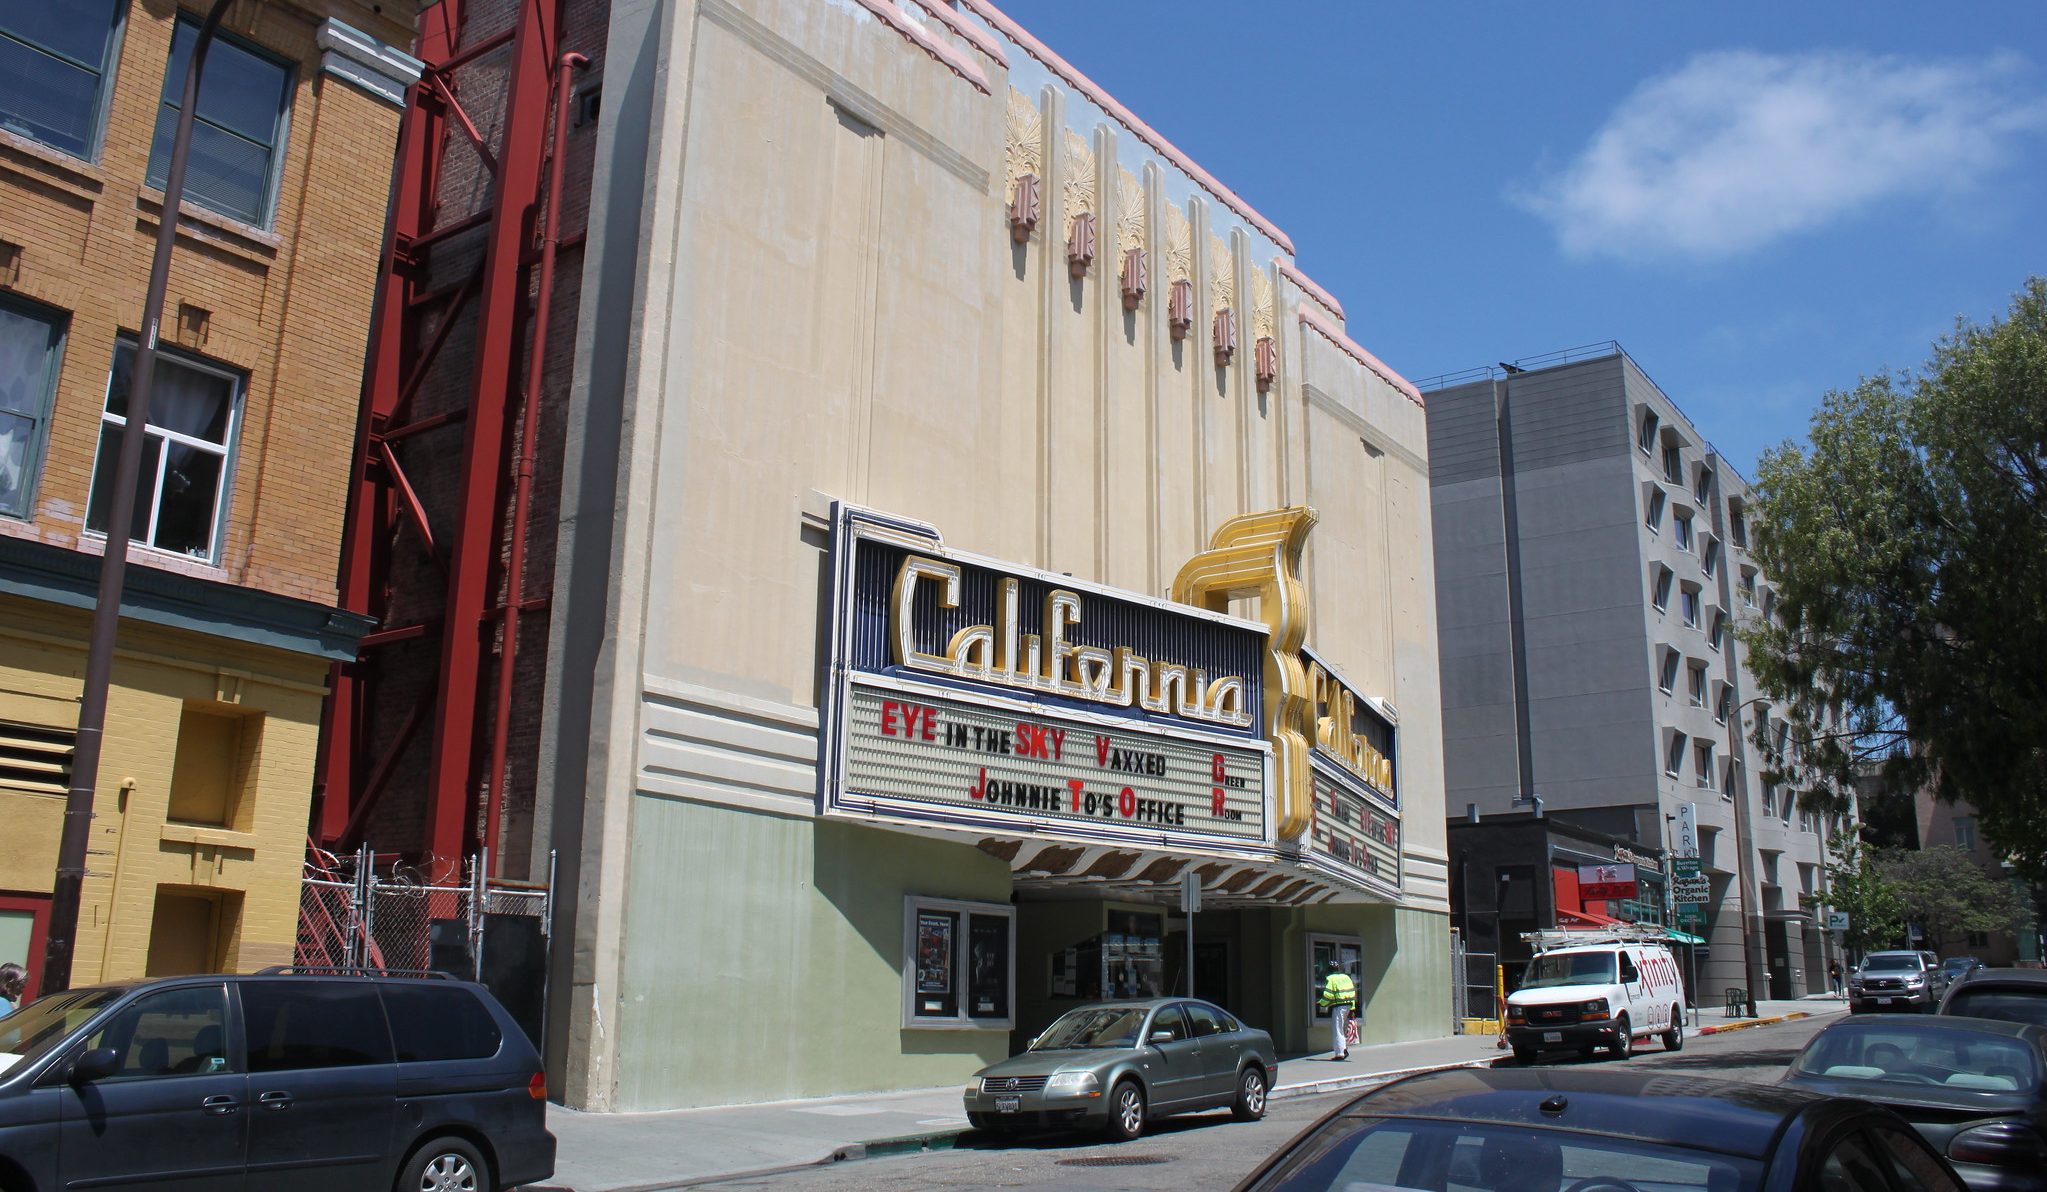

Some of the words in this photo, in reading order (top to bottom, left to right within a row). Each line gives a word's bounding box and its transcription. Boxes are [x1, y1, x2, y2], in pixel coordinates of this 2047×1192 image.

[891, 555, 1253, 727] California
[882, 701, 937, 741] EYE
[947, 722, 967, 748] IN
[974, 726, 1011, 754] THE
[1015, 723, 1066, 760] SKY
[1096, 735, 1166, 777] VAXXED
[1212, 753, 1246, 788] GREEN
[970, 767, 1061, 811] JOHNNIE
[1067, 778, 1114, 818] TO'S
[1119, 786, 1185, 826] OFFICE
[1212, 787, 1242, 821] ROOM
[1673, 886, 1709, 896] Organic
[1674, 894, 1709, 903] Kitchen
[1635, 949, 1679, 998] xfinity
